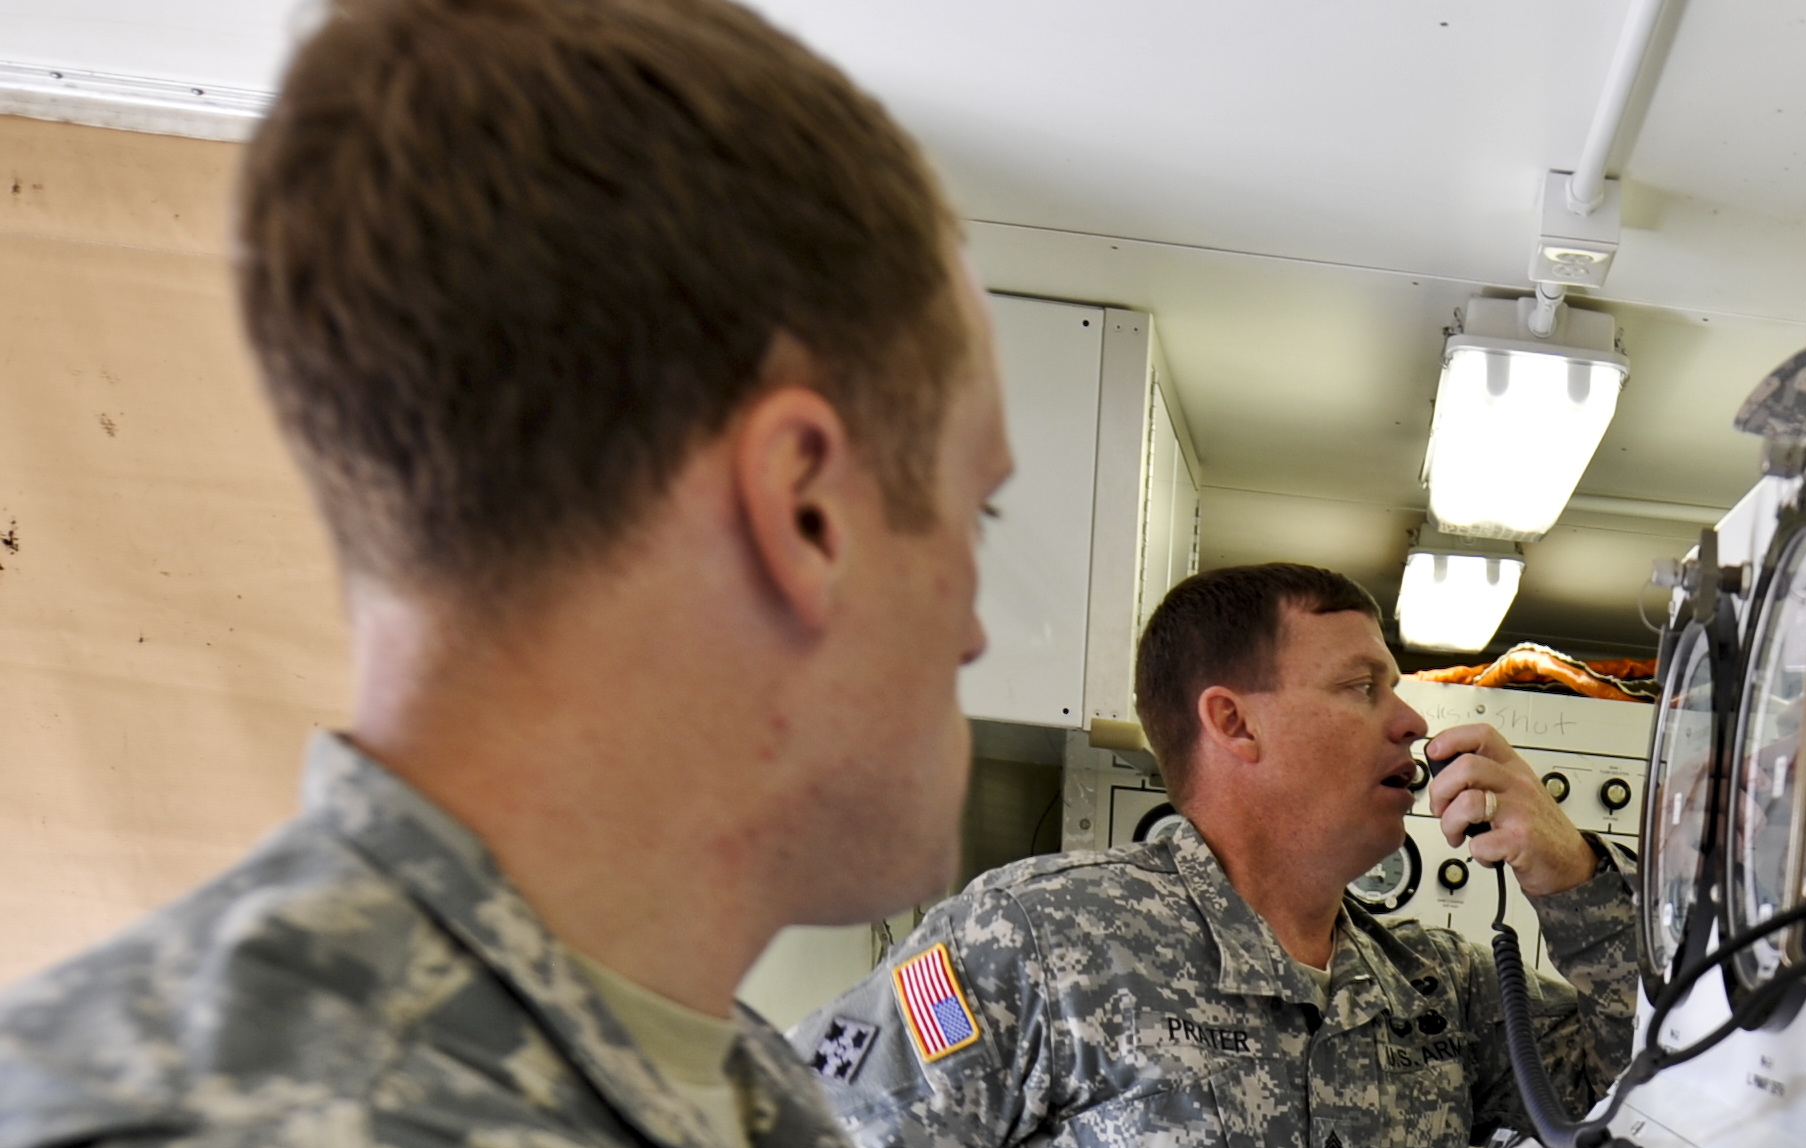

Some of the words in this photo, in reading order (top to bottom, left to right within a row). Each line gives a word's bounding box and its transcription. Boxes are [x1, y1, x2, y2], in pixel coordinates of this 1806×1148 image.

[1168, 1017, 1251, 1053] PRATER
[1385, 1045, 1420, 1068] U.S.
[1421, 1036, 1463, 1066] ARM
